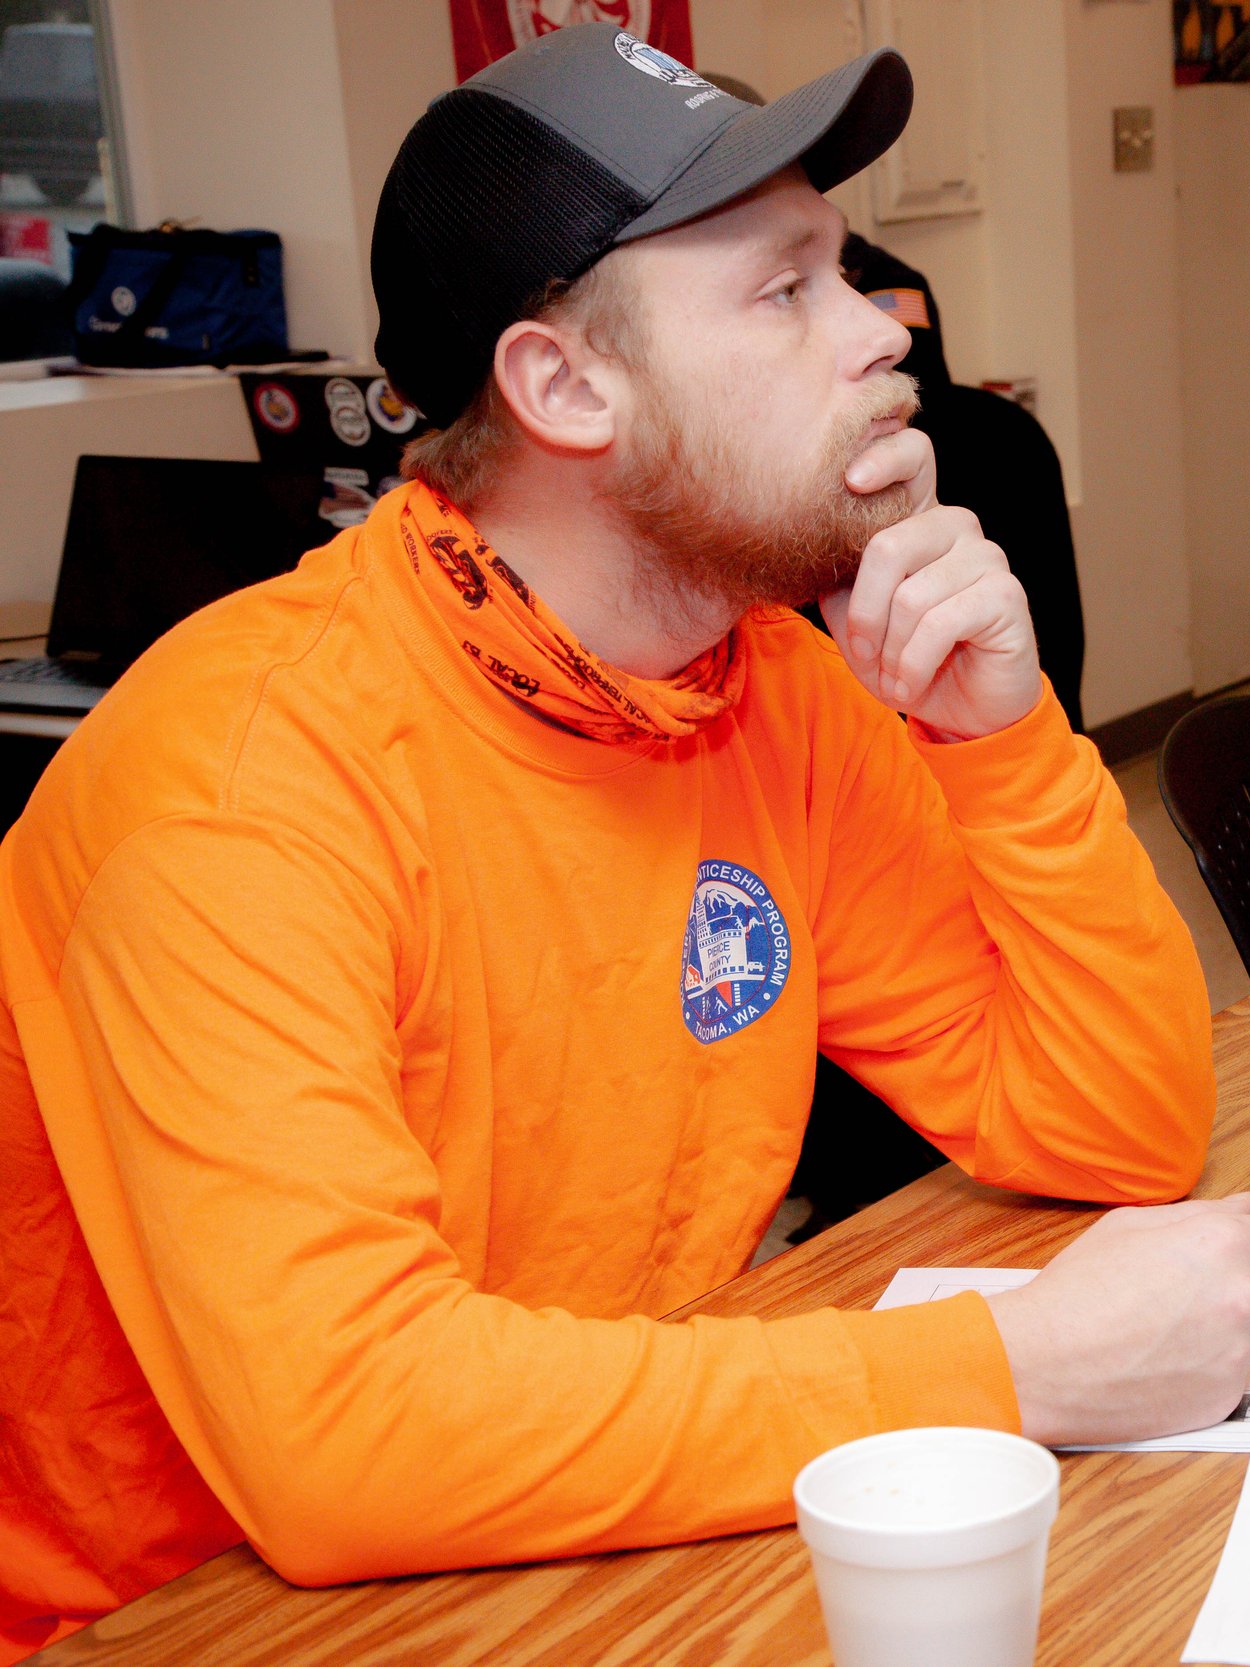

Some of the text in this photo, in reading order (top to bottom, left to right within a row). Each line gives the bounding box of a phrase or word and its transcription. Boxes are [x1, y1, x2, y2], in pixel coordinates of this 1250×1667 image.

[696, 863, 788, 986] NTICESHIP PROGRAM
[707, 941, 731, 959] PIERCE
[709, 954, 731, 971] COUNTY
[695, 1004, 760, 1041] TACOMA, WA
